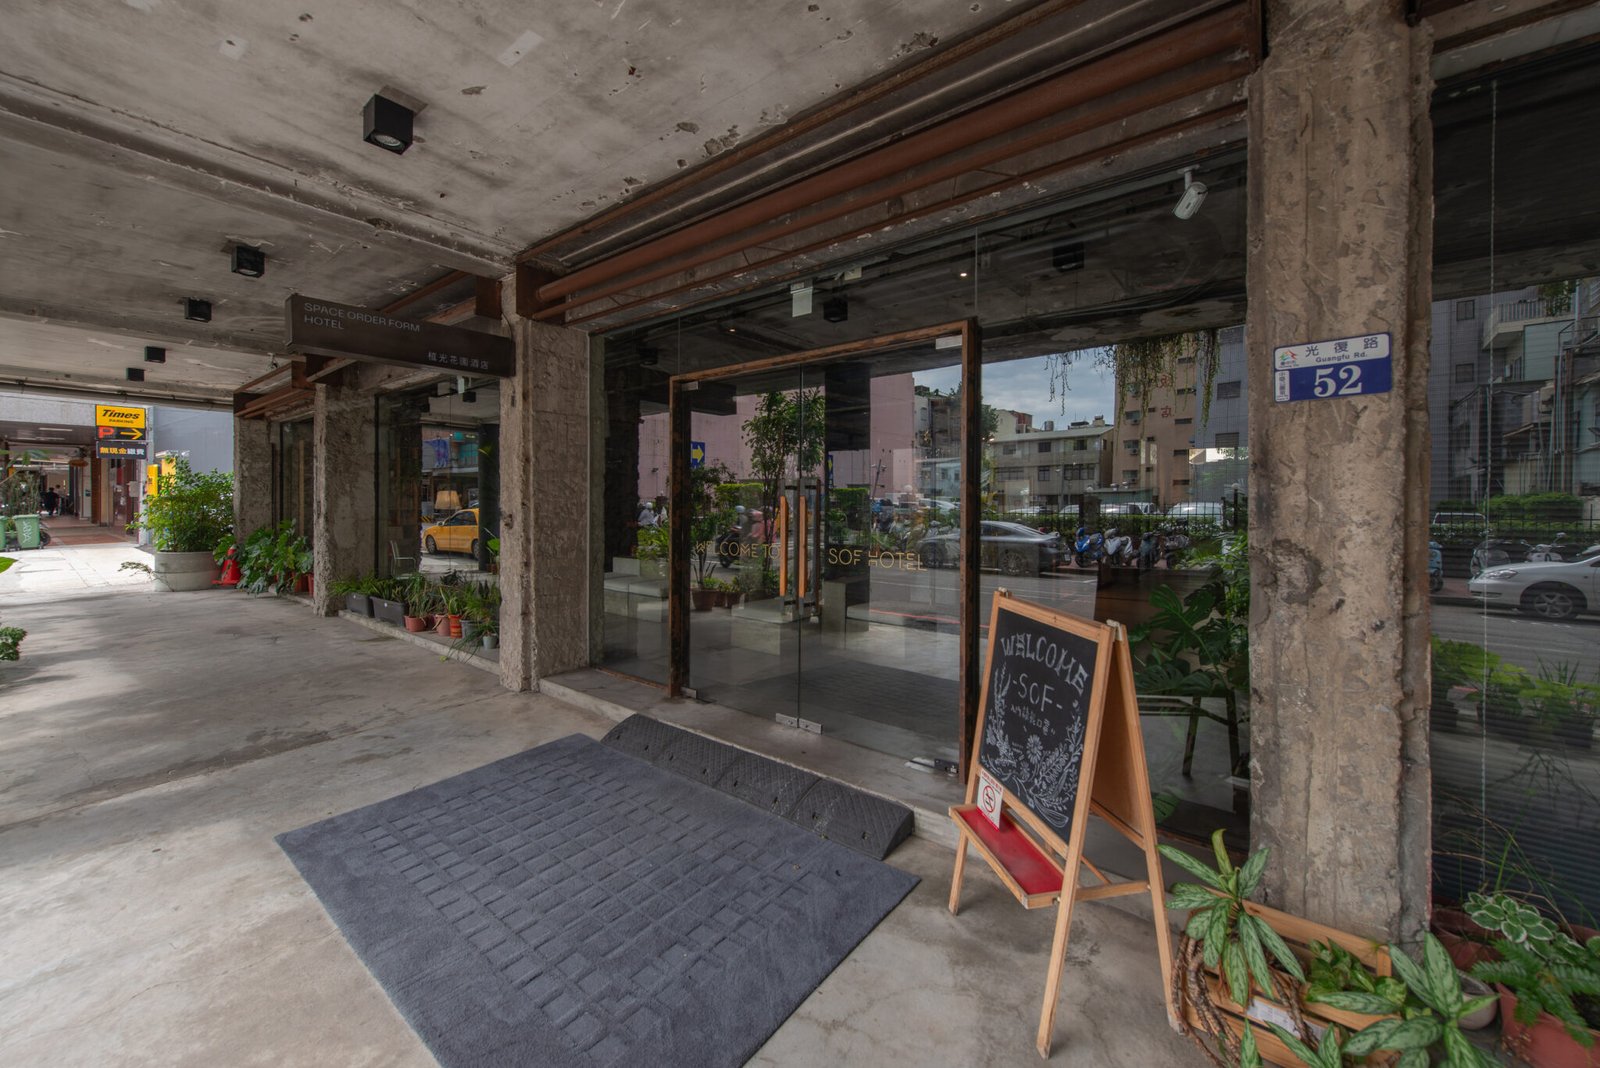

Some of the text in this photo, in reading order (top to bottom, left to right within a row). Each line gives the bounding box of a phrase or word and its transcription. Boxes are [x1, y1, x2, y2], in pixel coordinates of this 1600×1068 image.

[304, 303, 421, 333] SPACE ORDER FORM
[304, 315, 345, 330] HOTEL
[1305, 336, 1378, 358] 光復路
[1315, 354, 1350, 363] Guangfu
[1313, 364, 1362, 398] 52
[102, 409, 140, 419] Times
[98, 426, 115, 438] P
[695, 540, 760, 558] WELCOME
[828, 548, 927, 572] SOF HOTEL
[1000, 633, 1089, 696] WELCOME
